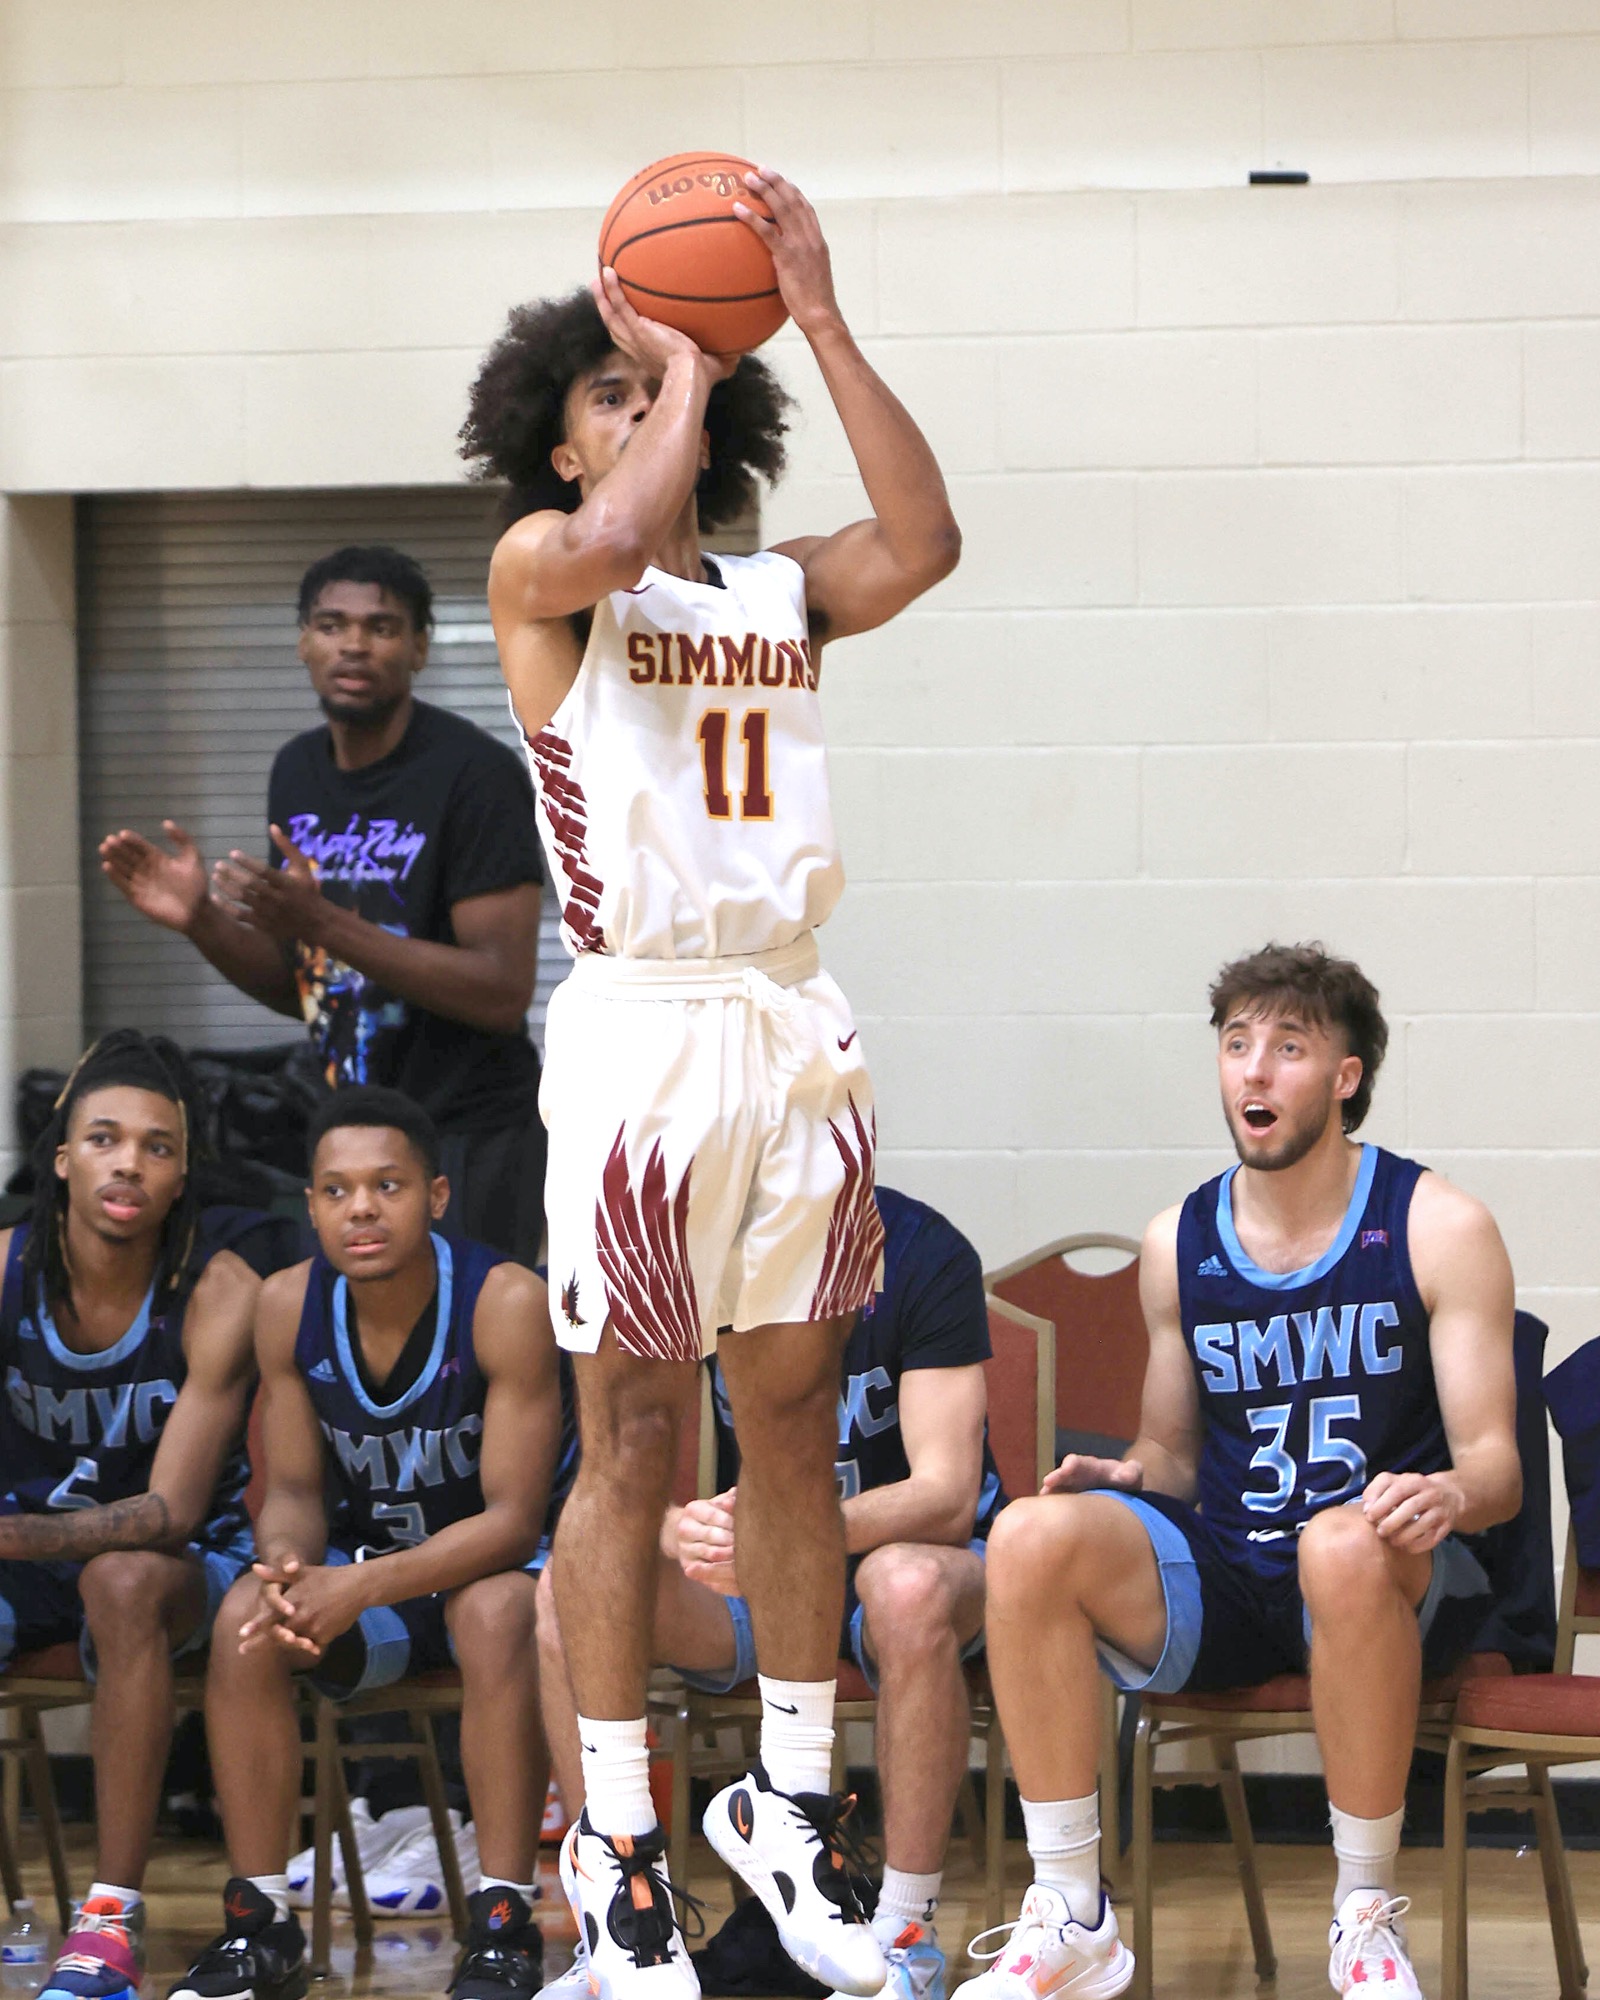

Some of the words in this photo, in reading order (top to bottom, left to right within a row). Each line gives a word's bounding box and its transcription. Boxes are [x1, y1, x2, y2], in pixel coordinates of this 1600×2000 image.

[645, 172, 760, 206] ilson
[695, 708, 775, 821] 11
[1193, 1301, 1403, 1393] SMWC
[319, 1413, 484, 1492] MWC
[1241, 1394, 1368, 1513] 35
